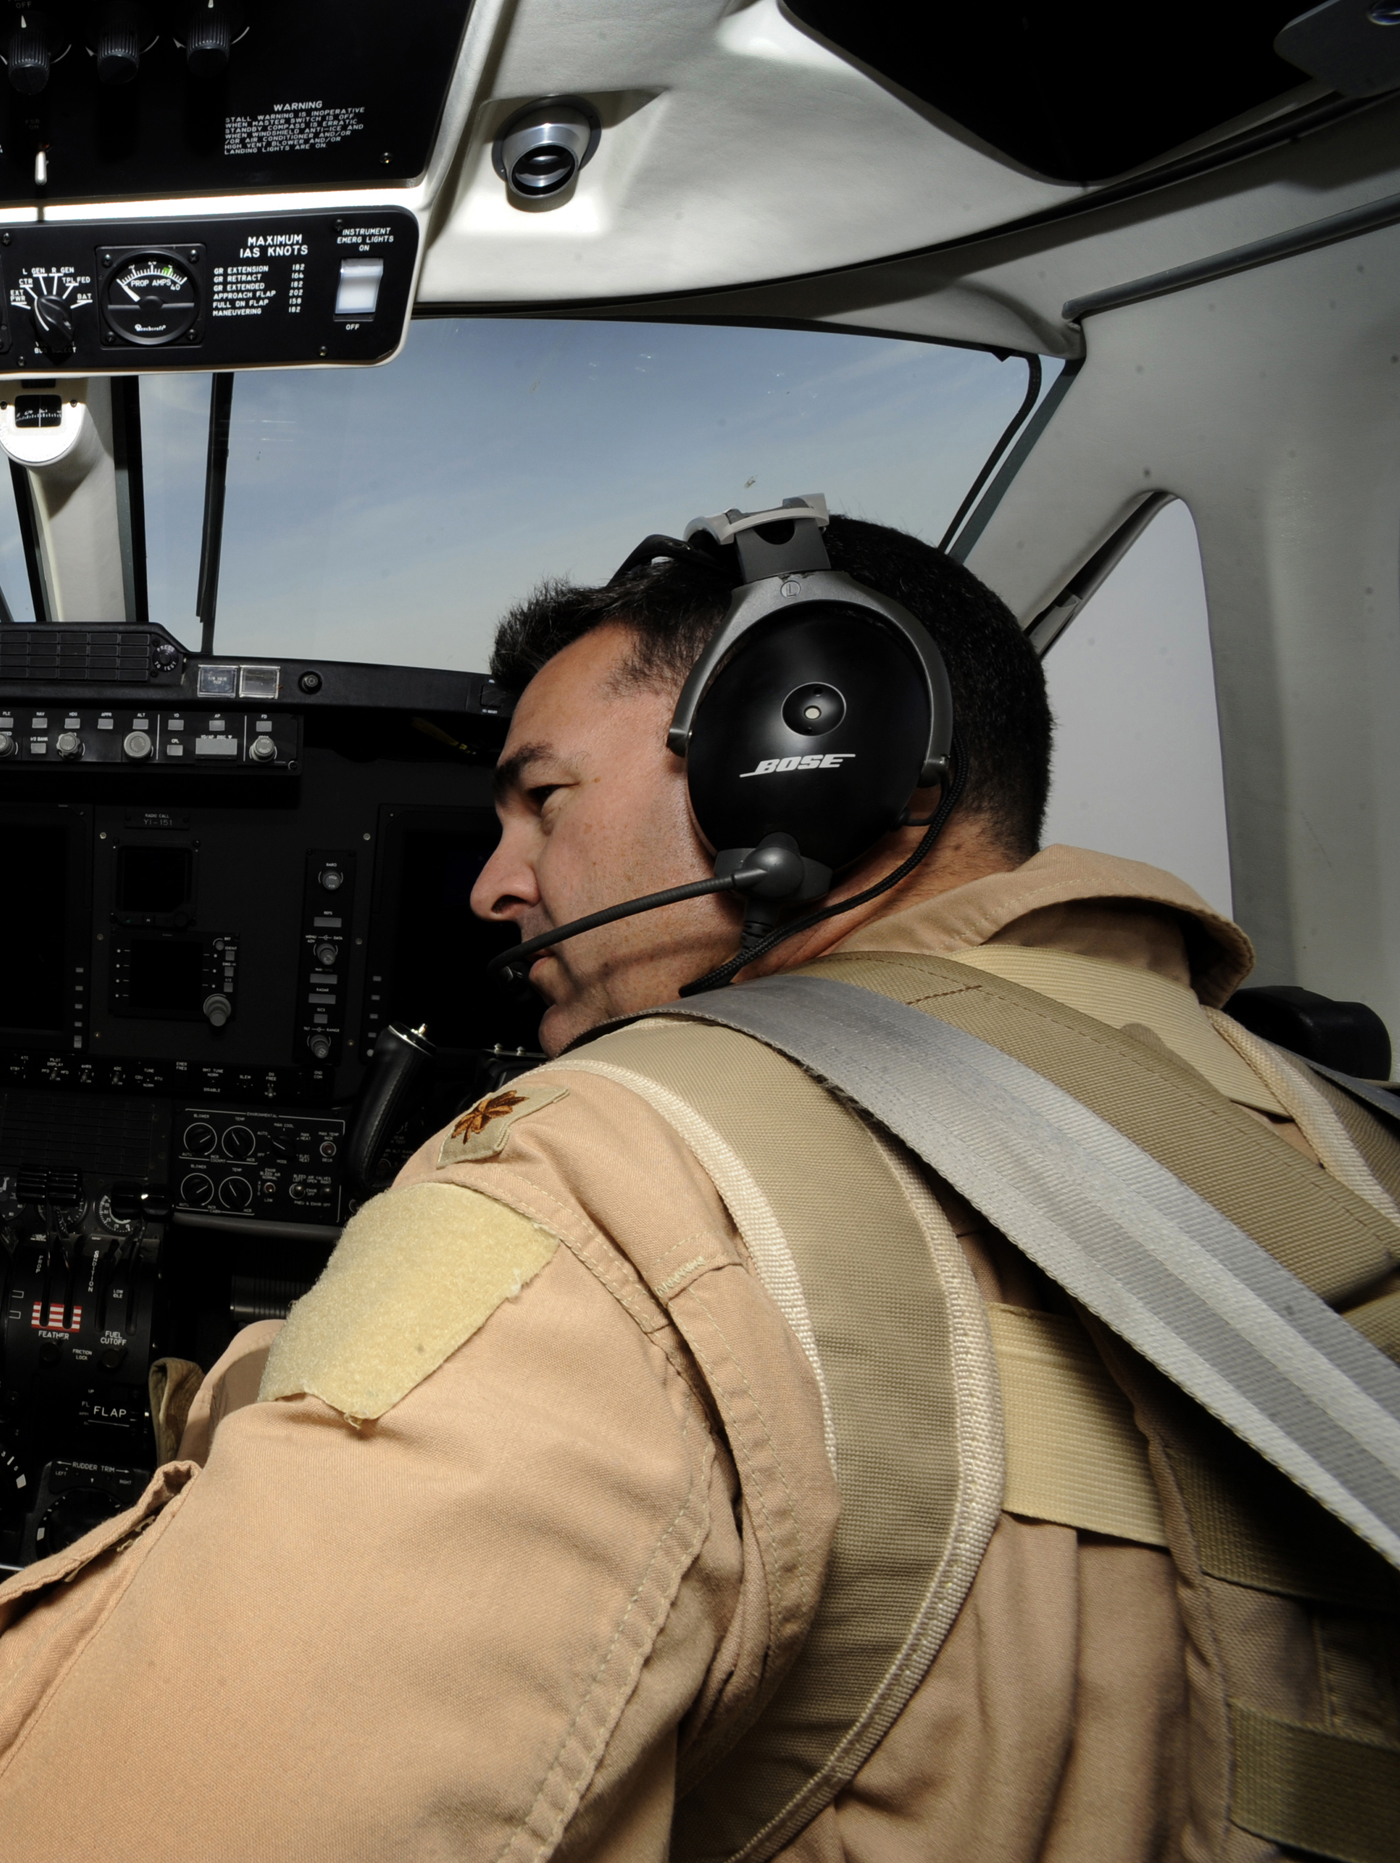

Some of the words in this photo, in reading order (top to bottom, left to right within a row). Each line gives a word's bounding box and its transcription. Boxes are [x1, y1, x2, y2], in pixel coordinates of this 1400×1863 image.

[274, 100, 322, 112] WARNING
[258, 112, 294, 120] WARNING
[312, 107, 365, 116] INOPERATIVE
[268, 123, 305, 131] COMPASS
[322, 118, 358, 126] ERRATIC
[290, 116, 321, 124] SWITCH
[252, 128, 300, 137] WINDSHIELD
[304, 125, 342, 133] ANTI-ICE
[262, 132, 314, 142] CONDITIONER
[319, 130, 351, 138] AND/OR
[272, 138, 304, 147] BLOWER
[309, 136, 341, 144] AND/OR
[342, 227, 391, 236] INSTRUMENT
[247, 234, 302, 247] MAXIMUM
[337, 236, 364, 244] EMERG
[366, 235, 394, 243] LIGHTS
[240, 248, 260, 258] IAS
[267, 245, 308, 257] KNOTS
[359, 244, 370, 252] ON
[60, 266, 75, 274] GEN
[214, 267, 224, 275] GR
[227, 265, 269, 274] EXTENSION
[131, 279, 150, 287] PROP
[227, 274, 262, 282] RETRACT
[226, 283, 265, 291] EXTENDED
[213, 292, 253, 300] APPROACH
[256, 290, 276, 298] FLAP
[249, 299, 269, 307] FLAP
[213, 308, 262, 316] MANEUVERING
[164, 661, 177, 671] TEST
[740, 753, 856, 778] BOSE
[144, 818, 172, 826] YI-151
[38, 1330, 70, 1340] FEATHER
[105, 1330, 122, 1338] FUEL
[100, 1337, 127, 1346] CUTOFF
[94, 1406, 127, 1418] FLAP
[72, 1461, 97, 1472] RUDDER
[100, 1465, 115, 1473] TRIM
